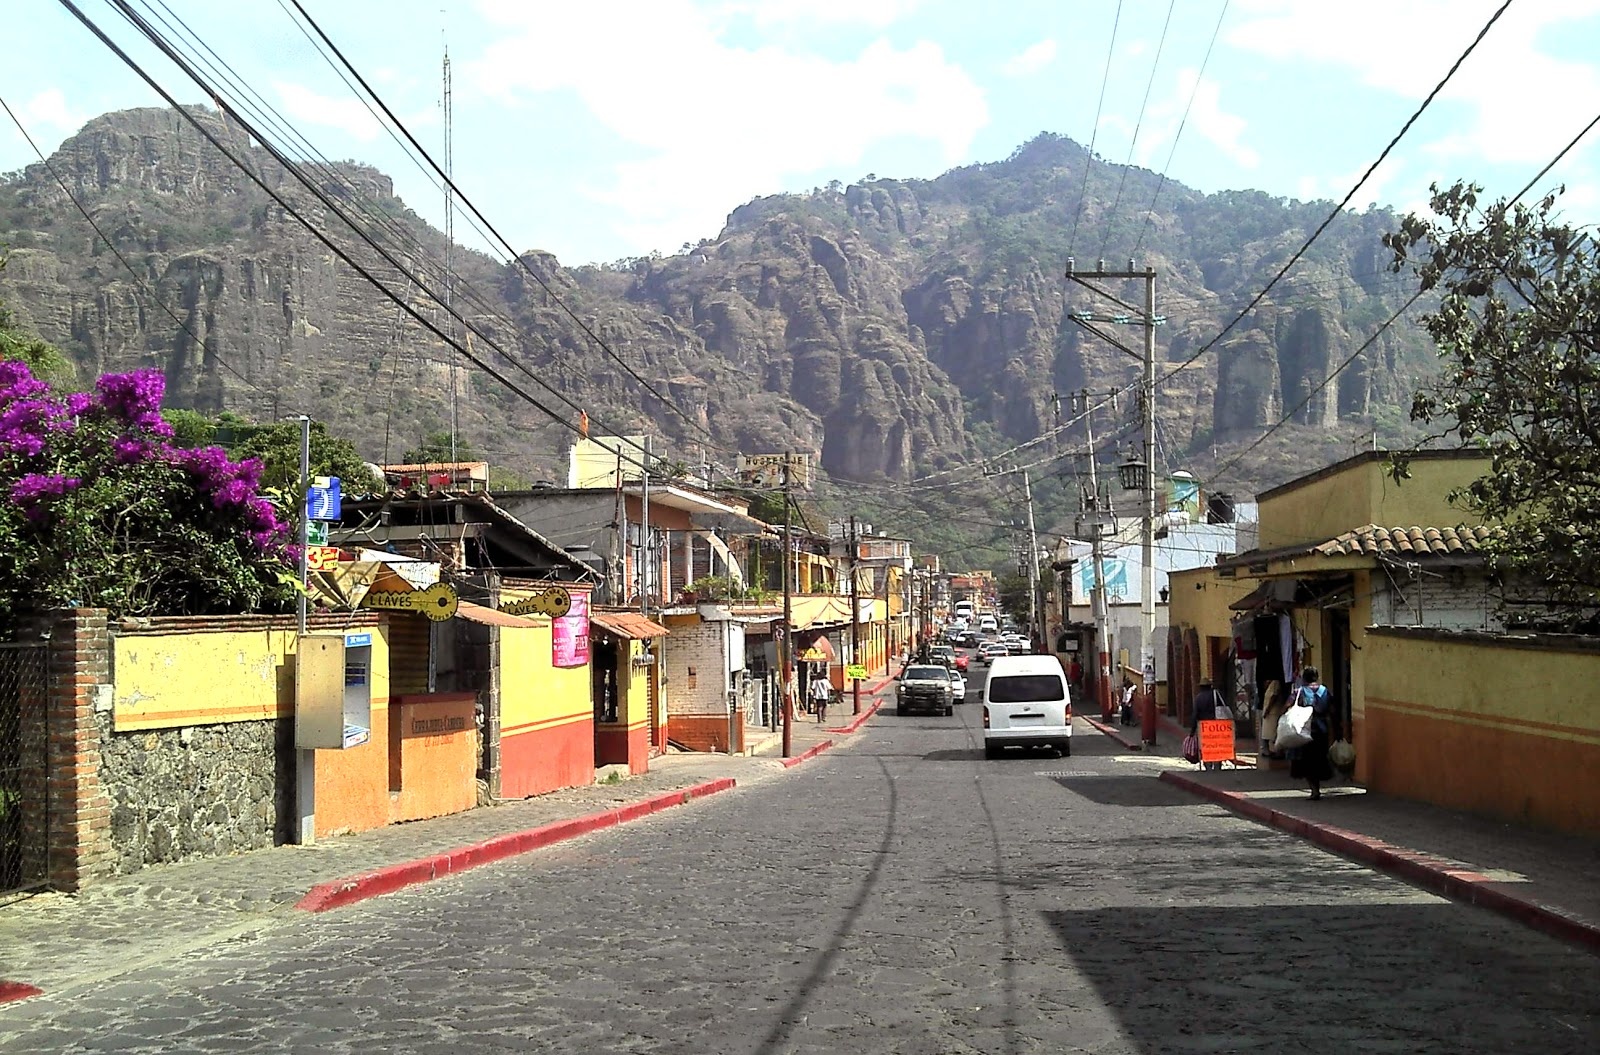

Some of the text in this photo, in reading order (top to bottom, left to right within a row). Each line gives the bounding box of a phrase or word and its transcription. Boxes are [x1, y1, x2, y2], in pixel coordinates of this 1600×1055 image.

[745, 456, 803, 466] HOSPEDJE
[369, 595, 413, 607] LLAVES
[503, 603, 538, 615] LAVES
[1201, 721, 1233, 733] Fotos
